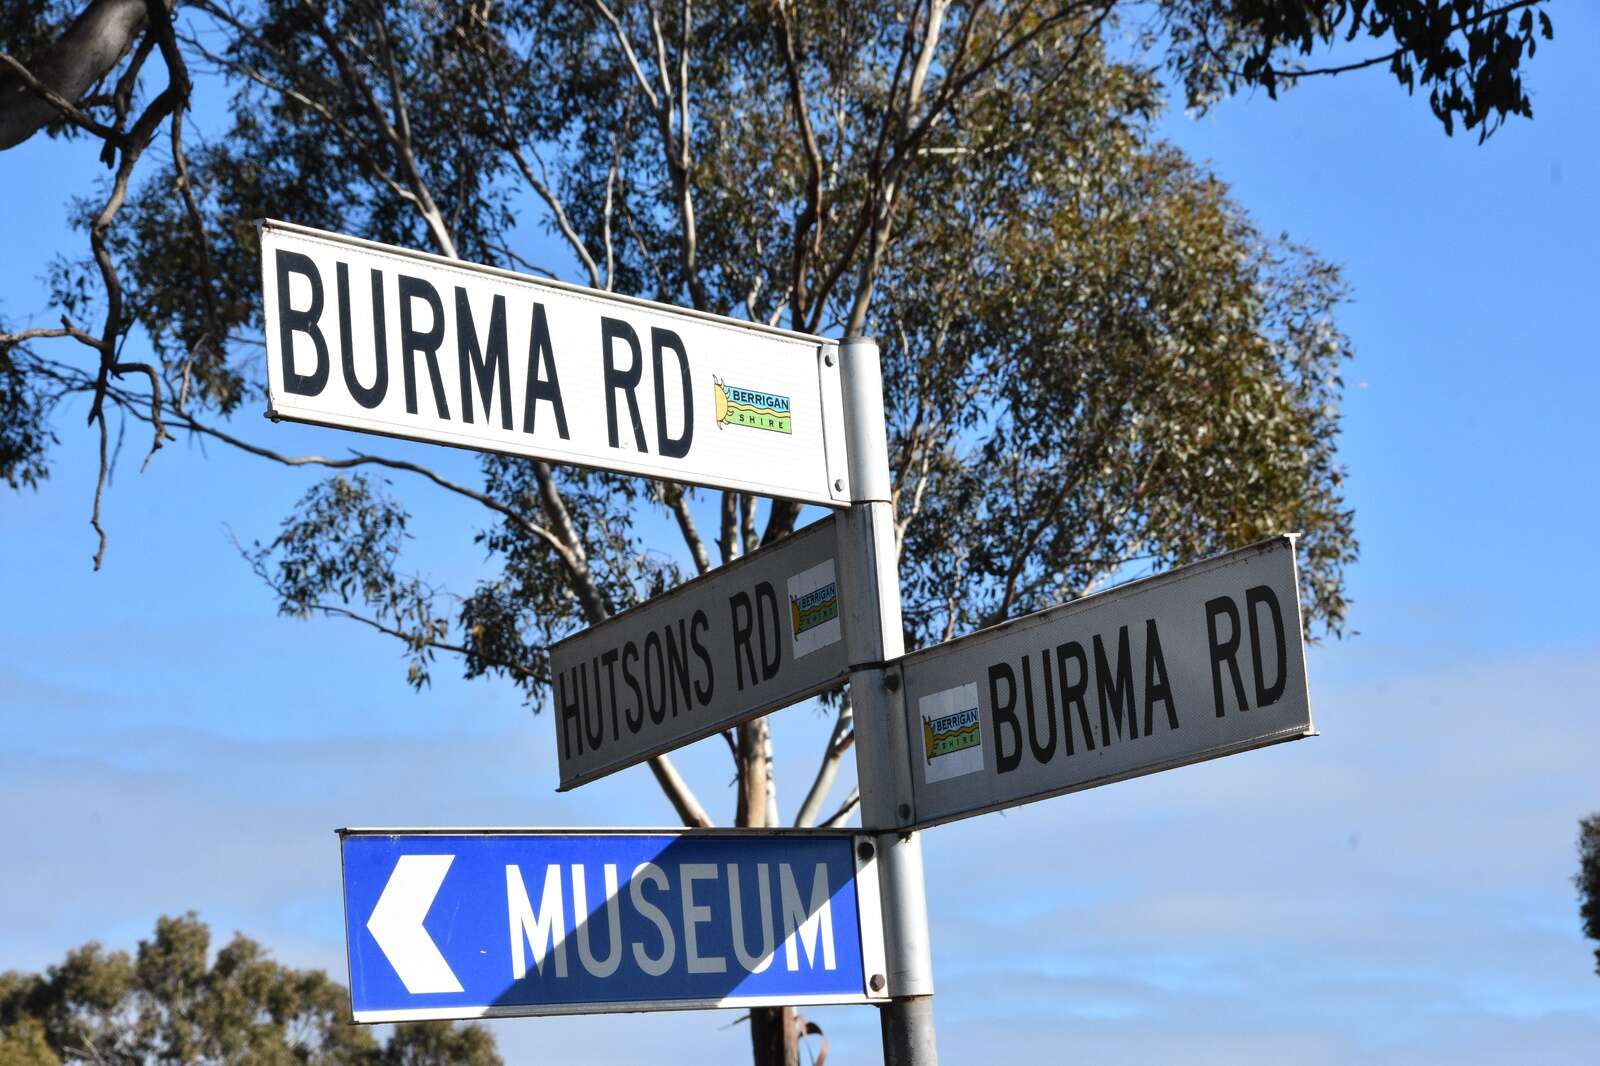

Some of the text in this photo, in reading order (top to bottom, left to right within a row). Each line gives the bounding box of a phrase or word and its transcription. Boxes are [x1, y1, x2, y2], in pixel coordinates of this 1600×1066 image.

[275, 248, 694, 459] BURMA RD
[732, 390, 790, 410] BERRIGAN
[739, 413, 784, 429] SHIRE
[801, 586, 836, 609] BERRIGAN
[559, 581, 781, 760] HUTSONS RD
[988, 584, 1287, 774] BURMA RD
[936, 710, 978, 731] BERRIGAN
[505, 861, 836, 980] MUSEUM
